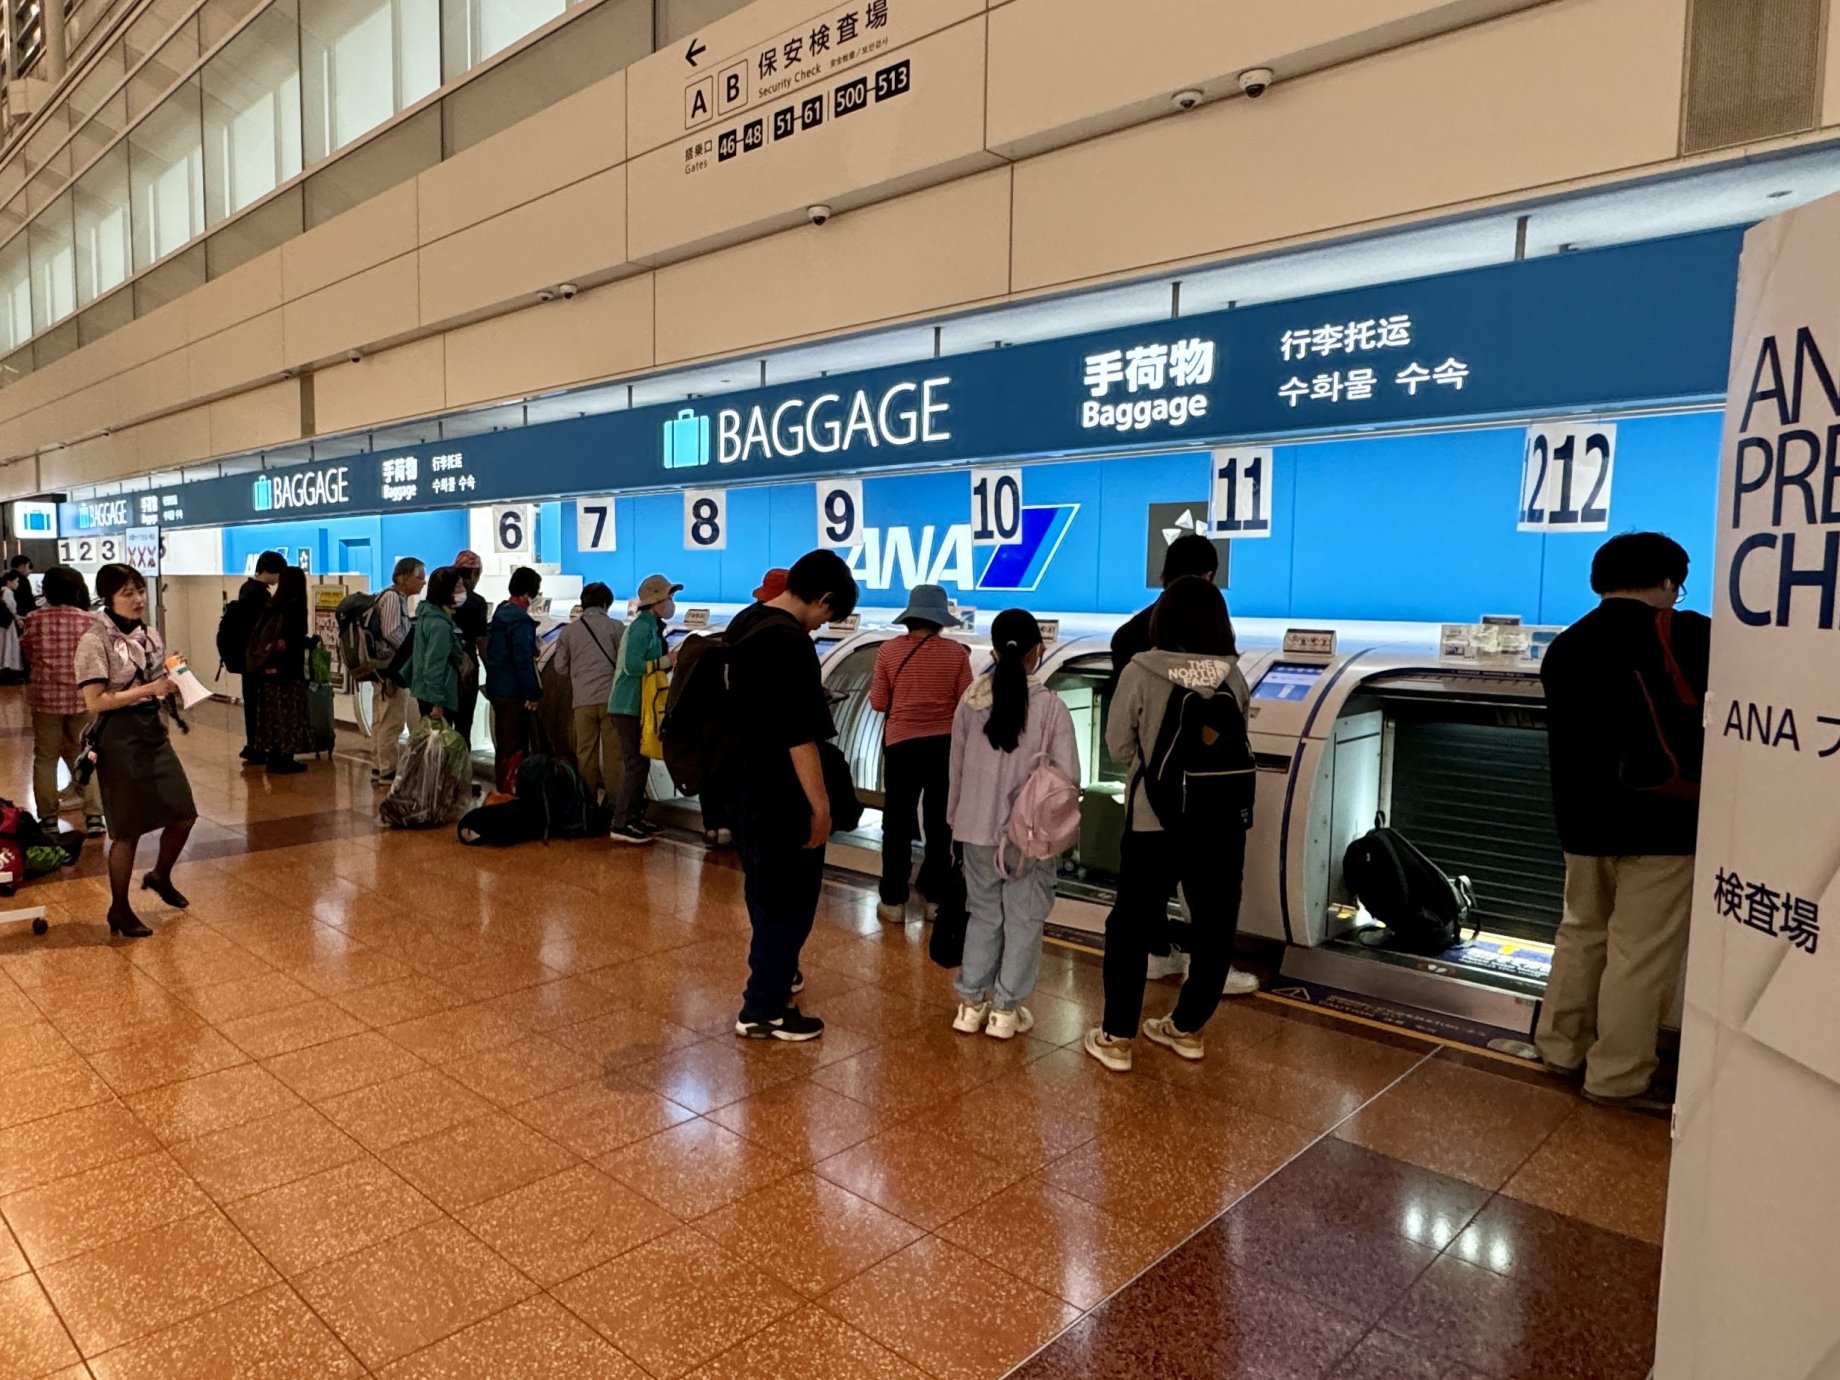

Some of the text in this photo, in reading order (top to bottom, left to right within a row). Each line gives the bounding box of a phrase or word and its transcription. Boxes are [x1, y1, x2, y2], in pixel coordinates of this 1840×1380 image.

[758, 0, 889, 80] 保安検査場
[691, 73, 740, 118] A B
[758, 63, 822, 99] Security Check
[685, 159, 708, 174] Gates
[1280, 314, 1412, 361] 行李托运
[1082, 338, 1217, 397] 手荷物
[1278, 356, 1471, 408] 수화물 수속
[717, 376, 951, 464] BAGGAGE
[1082, 392, 1208, 431] Baggage
[273, 467, 350, 510] BAGGAGE
[973, 475, 1021, 540] 10
[1216, 457, 1268, 532] 11
[89, 500, 128, 528] BAGGAGE
[499, 511, 523, 549] 6
[584, 506, 608, 549] 7
[691, 497, 720, 545] 8
[824, 489, 855, 543] 9
[60, 541, 75, 562] 1
[79, 541, 93, 561] 2
[101, 540, 115, 561] 3
[846, 524, 974, 590] ANA
[1168, 668, 1217, 680] NORTH
[1184, 677, 1218, 688] FACE
[1187, 660, 1214, 670] THE
[1723, 700, 1801, 752] ANA
[1714, 867, 1820, 955] 検査場
